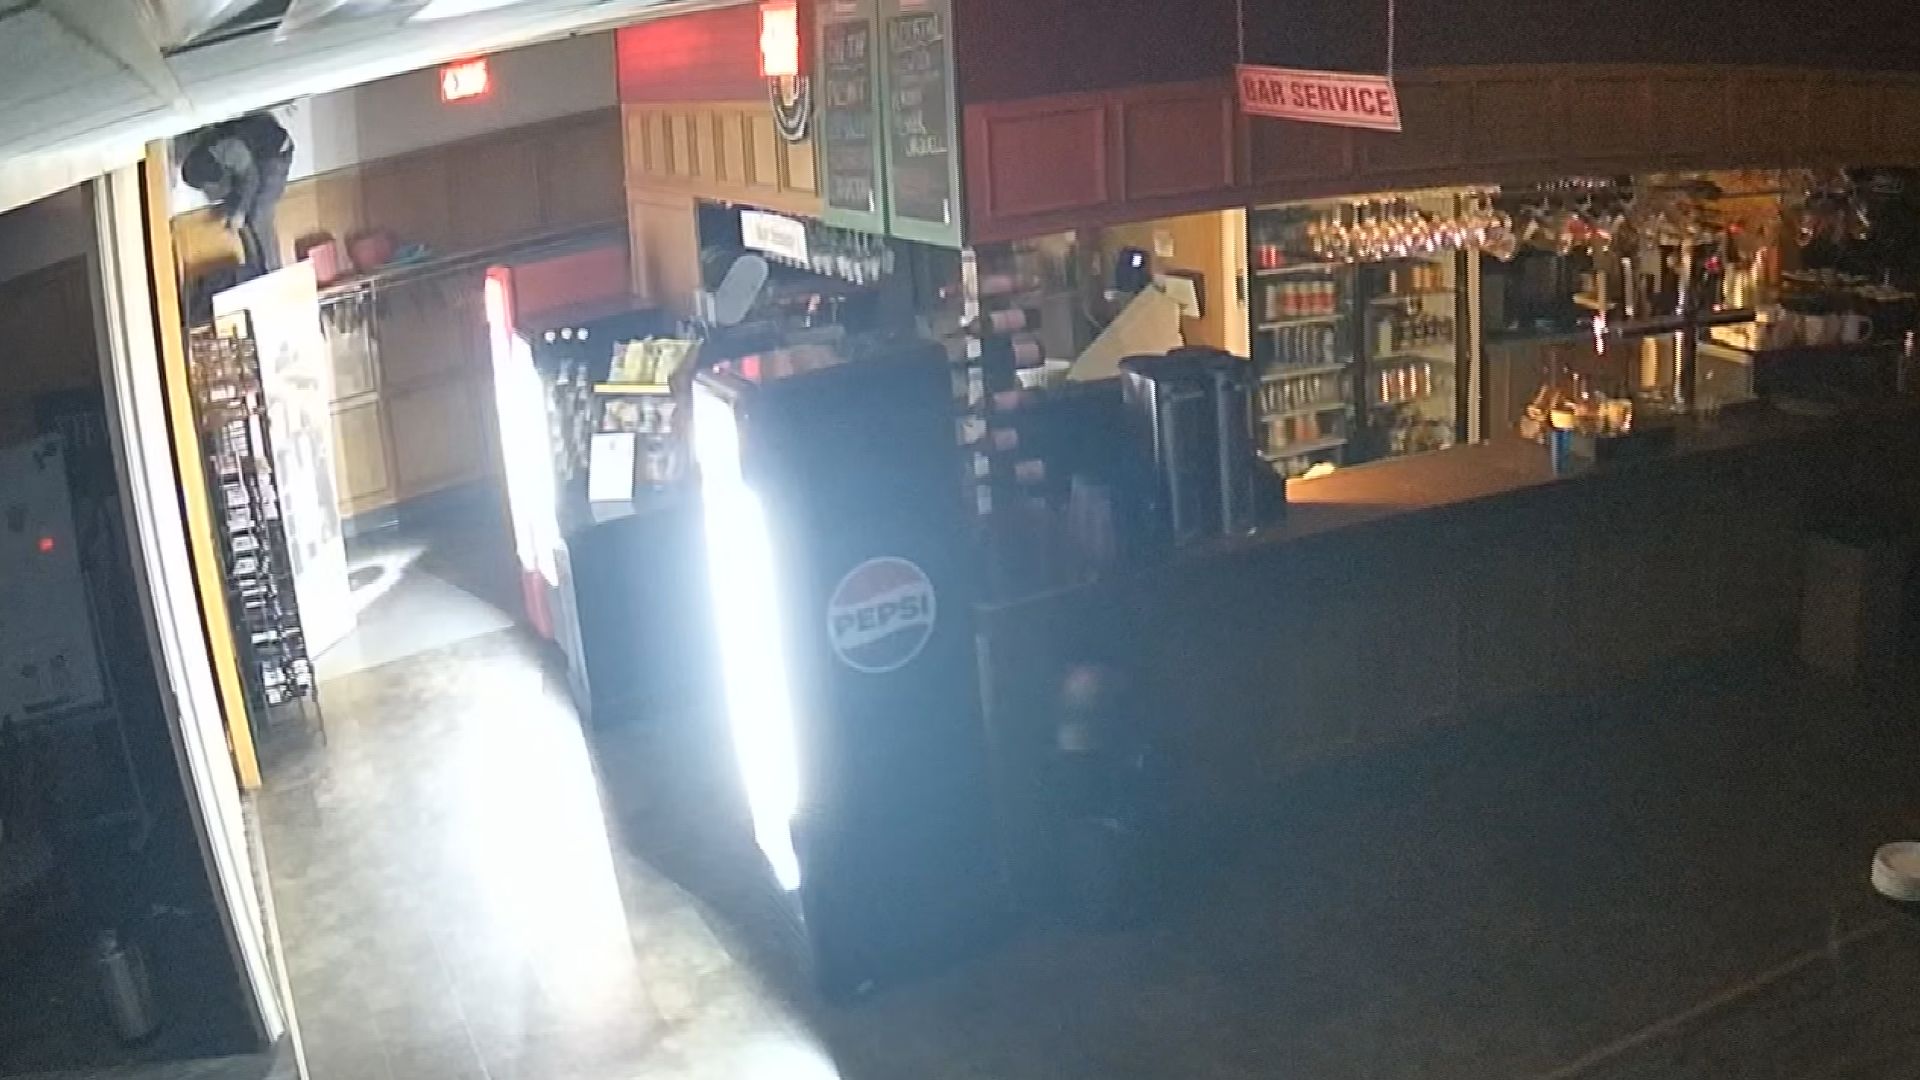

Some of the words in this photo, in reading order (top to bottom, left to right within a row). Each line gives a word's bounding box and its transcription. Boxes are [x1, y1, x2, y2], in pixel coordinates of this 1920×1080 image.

[1243, 77, 1285, 105] BAR
[1290, 81, 1393, 117] SERVICE
[833, 595, 928, 638] PEPSI
